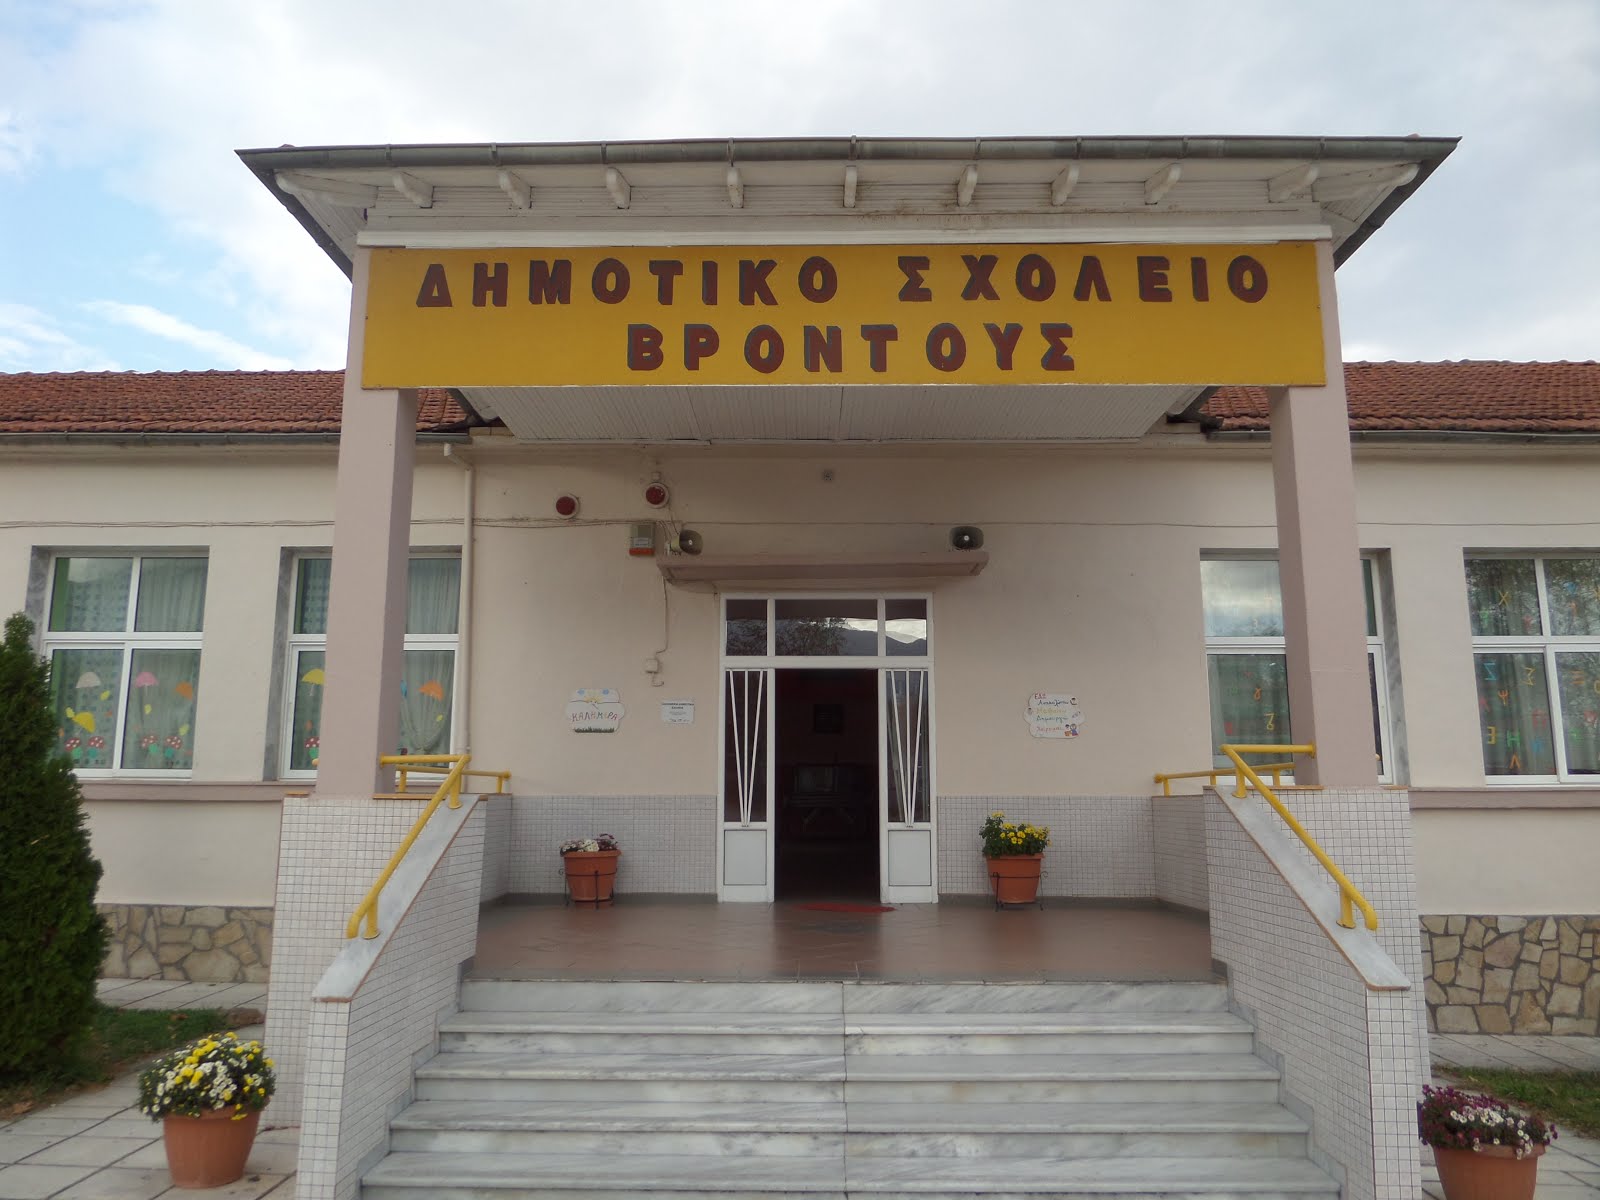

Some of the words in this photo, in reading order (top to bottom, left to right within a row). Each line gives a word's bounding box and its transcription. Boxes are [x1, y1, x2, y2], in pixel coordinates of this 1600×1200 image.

[416, 256, 838, 307] ΔΗΜΟΤΙΚΟ
[897, 253, 1268, 304] ΣΧΟΛΕΙΟ
[627, 323, 1075, 374] ΒΡΟΝΤΟΥΣ
